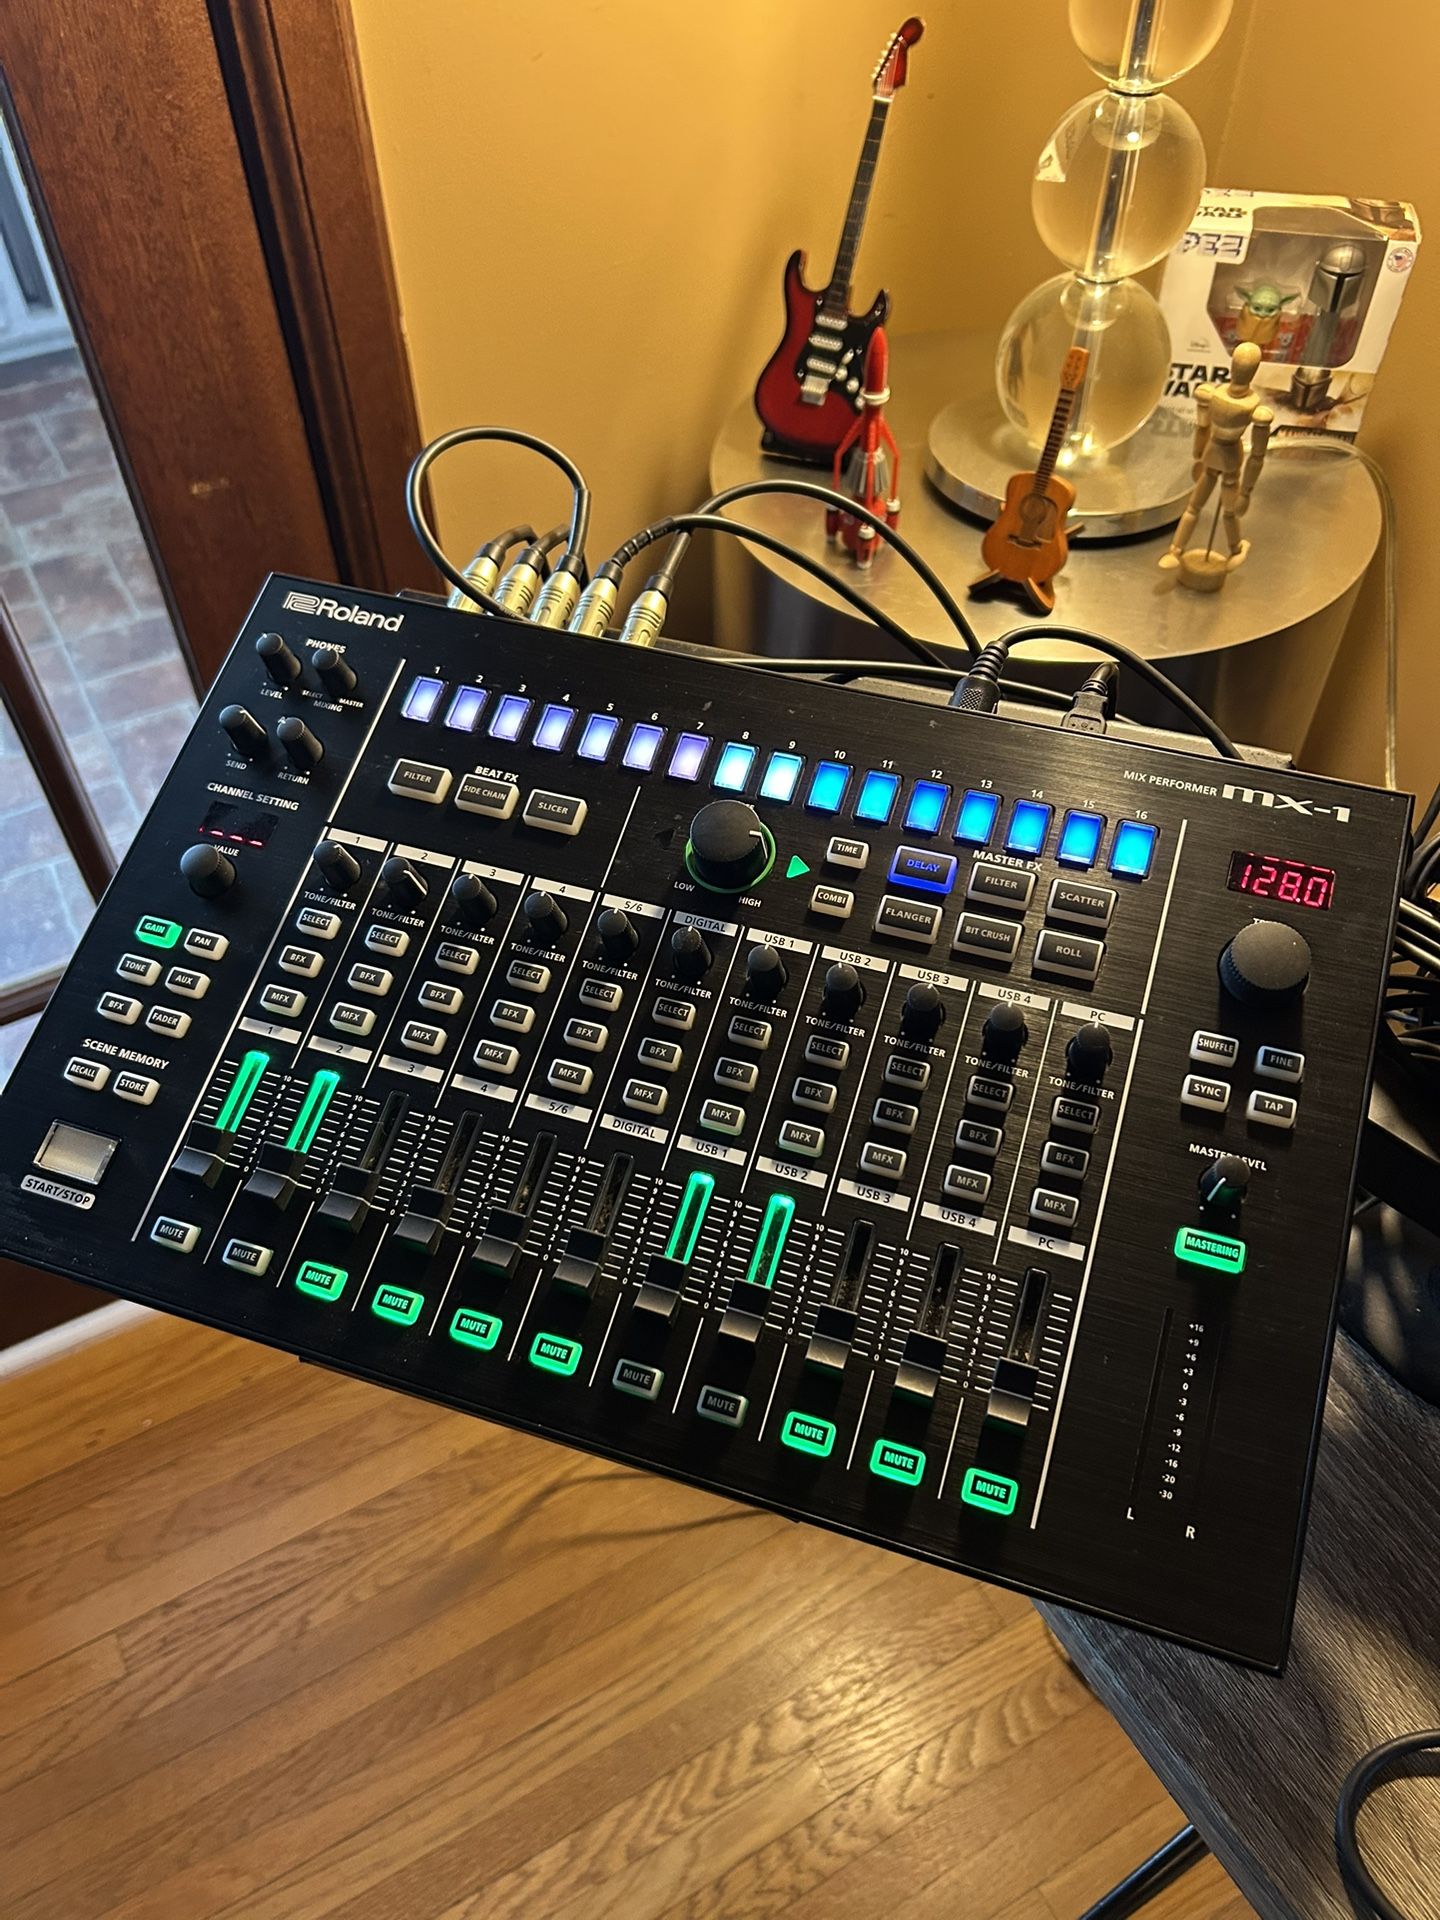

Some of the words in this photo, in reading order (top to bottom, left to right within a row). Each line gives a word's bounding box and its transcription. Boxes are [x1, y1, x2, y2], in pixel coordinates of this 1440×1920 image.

[1169, 363, 1231, 382] TAR
[316, 599, 404, 631] Roland
[306, 639, 346, 653] PHONES
[476, 675, 483, 683] 2
[260, 688, 283, 699] LEVEL
[519, 684, 526, 693] 3
[339, 698, 363, 708] MASTER
[563, 694, 570, 702] 4
[313, 701, 343, 712] MIXING
[607, 703, 614, 711] 5
[651, 712, 658, 720] 6
[697, 722, 704, 730] 7
[742, 731, 749, 740] 8
[789, 741, 796, 749] 9
[834, 750, 846, 759] 10
[226, 759, 247, 769] SEND
[882, 760, 893, 769] 11
[277, 772, 309, 785] RETURN
[403, 771, 431, 783] FILTER
[475, 766, 503, 778] BEAT
[503, 772, 519, 782] FX
[931, 770, 942, 779] 12
[981, 780, 992, 789] 13
[1123, 770, 1146, 782] MIX
[1149, 776, 1217, 796] PERFORMER
[207, 781, 253, 800] CHANNEL
[256, 794, 299, 811] SETTING
[463, 784, 481, 795] SIDE
[482, 790, 506, 800] CHAIN
[1032, 789, 1043, 799] 14
[538, 801, 568, 815] SLICER
[1083, 800, 1095, 809] 15
[1135, 810, 1148, 820] 16
[215, 845, 239, 856] VALUE
[837, 844, 857, 854] TIME
[906, 858, 941, 872] DELAY
[973, 850, 1023, 867] MASTER
[1026, 861, 1042, 871] FX
[489, 869, 496, 877] 3
[674, 881, 695, 892] LOW
[985, 876, 1017, 889] FILTER
[1241, 864, 1328, 907] 128.0
[559, 885, 566, 893] 4
[304, 891, 356, 911] TONE/FILTER
[739, 896, 761, 908] HIGH
[818, 892, 846, 904] COMBI
[1059, 892, 1104, 907] SCATTER
[624, 900, 643, 911] 5/6
[302, 913, 330, 927] SELECT
[372, 908, 425, 928] TONE/FILTER
[885, 907, 931, 923] FLANGER
[145, 922, 165, 934] GAIN
[684, 915, 726, 932] DIGITAL
[371, 930, 399, 944] SELECT
[965, 926, 980, 936] BIT
[981, 928, 1010, 942] CRUSH
[195, 935, 211, 947] PAN
[764, 934, 786, 946] USB
[790, 939, 794, 947] 1
[440, 948, 470, 962] SELECT
[510, 943, 565, 962] TONE/FILTER
[1056, 945, 1081, 957] ROLL
[290, 953, 306, 963] BFX
[840, 951, 861, 964] USB
[864, 957, 871, 966] 2
[125, 961, 146, 973] TONE
[176, 975, 193, 985] AUX
[359, 971, 376, 981] BFX
[917, 970, 941, 983] USB
[944, 975, 950, 985] 3
[655, 978, 711, 999] TONE/FILTER
[271, 992, 290, 1003] MFX
[998, 989, 1022, 1002] USB
[1024, 995, 1031, 1004] 4
[108, 1001, 124, 1011] BFX
[729, 996, 787, 1018] TONE/FILTER
[152, 1012, 179, 1026] FADER
[341, 1010, 359, 1022] MFX
[502, 1008, 519, 1018] BFX
[1090, 1011, 1106, 1022] PC
[734, 1021, 765, 1036] SELECT
[336, 1045, 343, 1053] 2
[650, 1046, 667, 1056] BFX
[1198, 1038, 1233, 1053] SHUFFLE
[83, 1038, 116, 1055] SCENE
[118, 1046, 169, 1069] MEMORY
[484, 1048, 504, 1059] MFX
[965, 1055, 1029, 1079] TONE/FILTER
[1270, 1055, 1293, 1068] FINE
[70, 1063, 95, 1079] RECALL
[120, 1079, 146, 1092] STORE
[481, 1084, 487, 1092] 4
[1049, 1076, 1114, 1100] TONE/FILTER
[1193, 1083, 1221, 1097] SYNC
[634, 1088, 654, 1100] MFX
[549, 1103, 568, 1114] 5/6
[1264, 1101, 1283, 1111] TAP
[711, 1108, 731, 1120] MFX
[1058, 1105, 1094, 1120] SELECT
[612, 1119, 656, 1139] DIGITAL
[790, 1130, 812, 1142] MFX
[696, 1142, 719, 1156] USB
[723, 1149, 727, 1158] 1
[775, 1163, 797, 1178] USB
[801, 1172, 808, 1180] 2
[956, 1174, 979, 1189] MFX
[25, 1178, 91, 1205] START/STOP
[857, 1186, 880, 1200] USB
[883, 1194, 891, 1203] 3
[1044, 1199, 1067, 1212] MFX
[941, 1210, 966, 1224] USB
[968, 1217, 976, 1227] 4
[160, 1224, 184, 1239] MUTE
[1038, 1237, 1055, 1249] PC
[1187, 1237, 1238, 1256] MASTERING
[232, 1247, 257, 1261] MUTE
[306, 1270, 332, 1285] MUTE
[460, 1318, 487, 1333] MUTE
[1189, 1323, 1204, 1332] +16
[1189, 1338, 1199, 1347] +9
[540, 1343, 567, 1359] MUTE
[1186, 1353, 1196, 1362] +6
[1183, 1368, 1193, 1376] +3
[1183, 1383, 1189, 1391] 0
[707, 1395, 735, 1412] MUTE
[1179, 1398, 1187, 1406] -3
[1176, 1413, 1184, 1421] -6
[795, 1425, 823, 1441] MUTE
[1173, 1429, 1182, 1437] -9
[1168, 1443, 1181, 1452] -12
[884, 1452, 914, 1469] MUTE
[1165, 1459, 1178, 1468] -16
[1162, 1474, 1175, 1484] -20
[976, 1481, 1006, 1498] MUTE
[1159, 1490, 1173, 1499] -30
[1126, 1507, 1134, 1520] L
[1185, 1525, 1195, 1539] R
